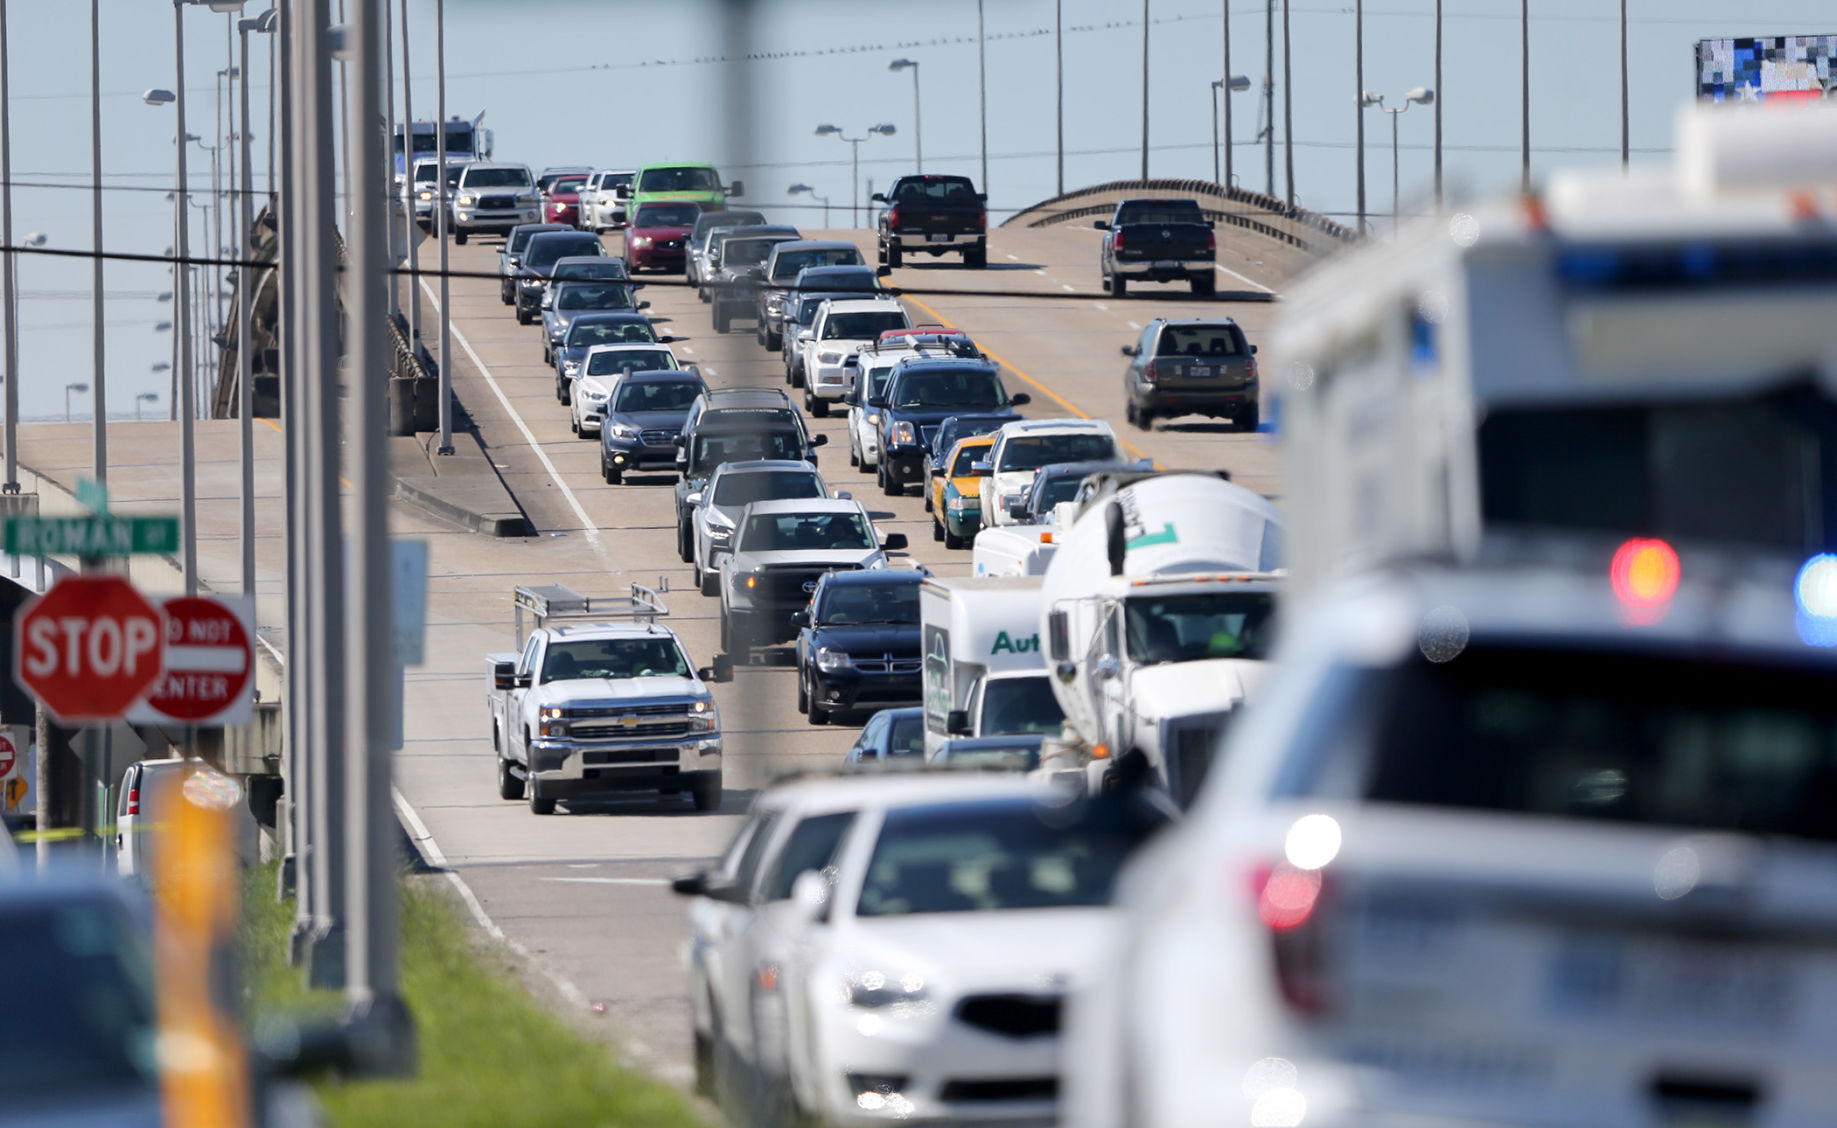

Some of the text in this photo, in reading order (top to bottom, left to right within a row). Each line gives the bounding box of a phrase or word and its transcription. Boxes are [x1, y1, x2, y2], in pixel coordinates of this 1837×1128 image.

[16, 520, 133, 551] ROMAN
[188, 617, 231, 642] NOT
[26, 616, 157, 677] STOP
